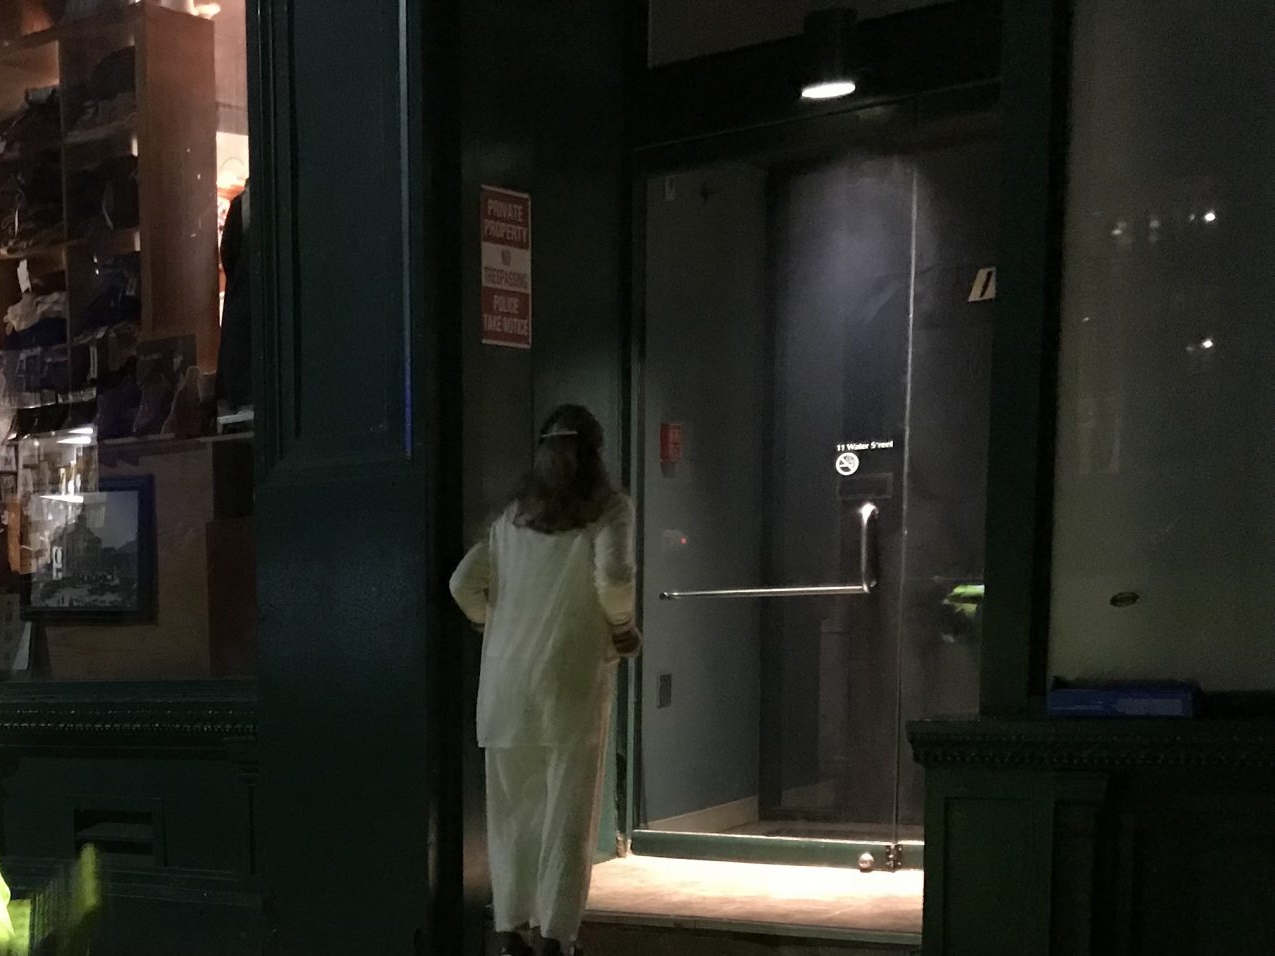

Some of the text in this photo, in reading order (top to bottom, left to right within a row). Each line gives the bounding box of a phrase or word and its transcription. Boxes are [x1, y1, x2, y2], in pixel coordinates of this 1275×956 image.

[488, 199, 523, 222] PRIVATE
[484, 219, 527, 242] PROPERTY
[493, 294, 519, 314] POLICE
[483, 313, 502, 332] TAKE
